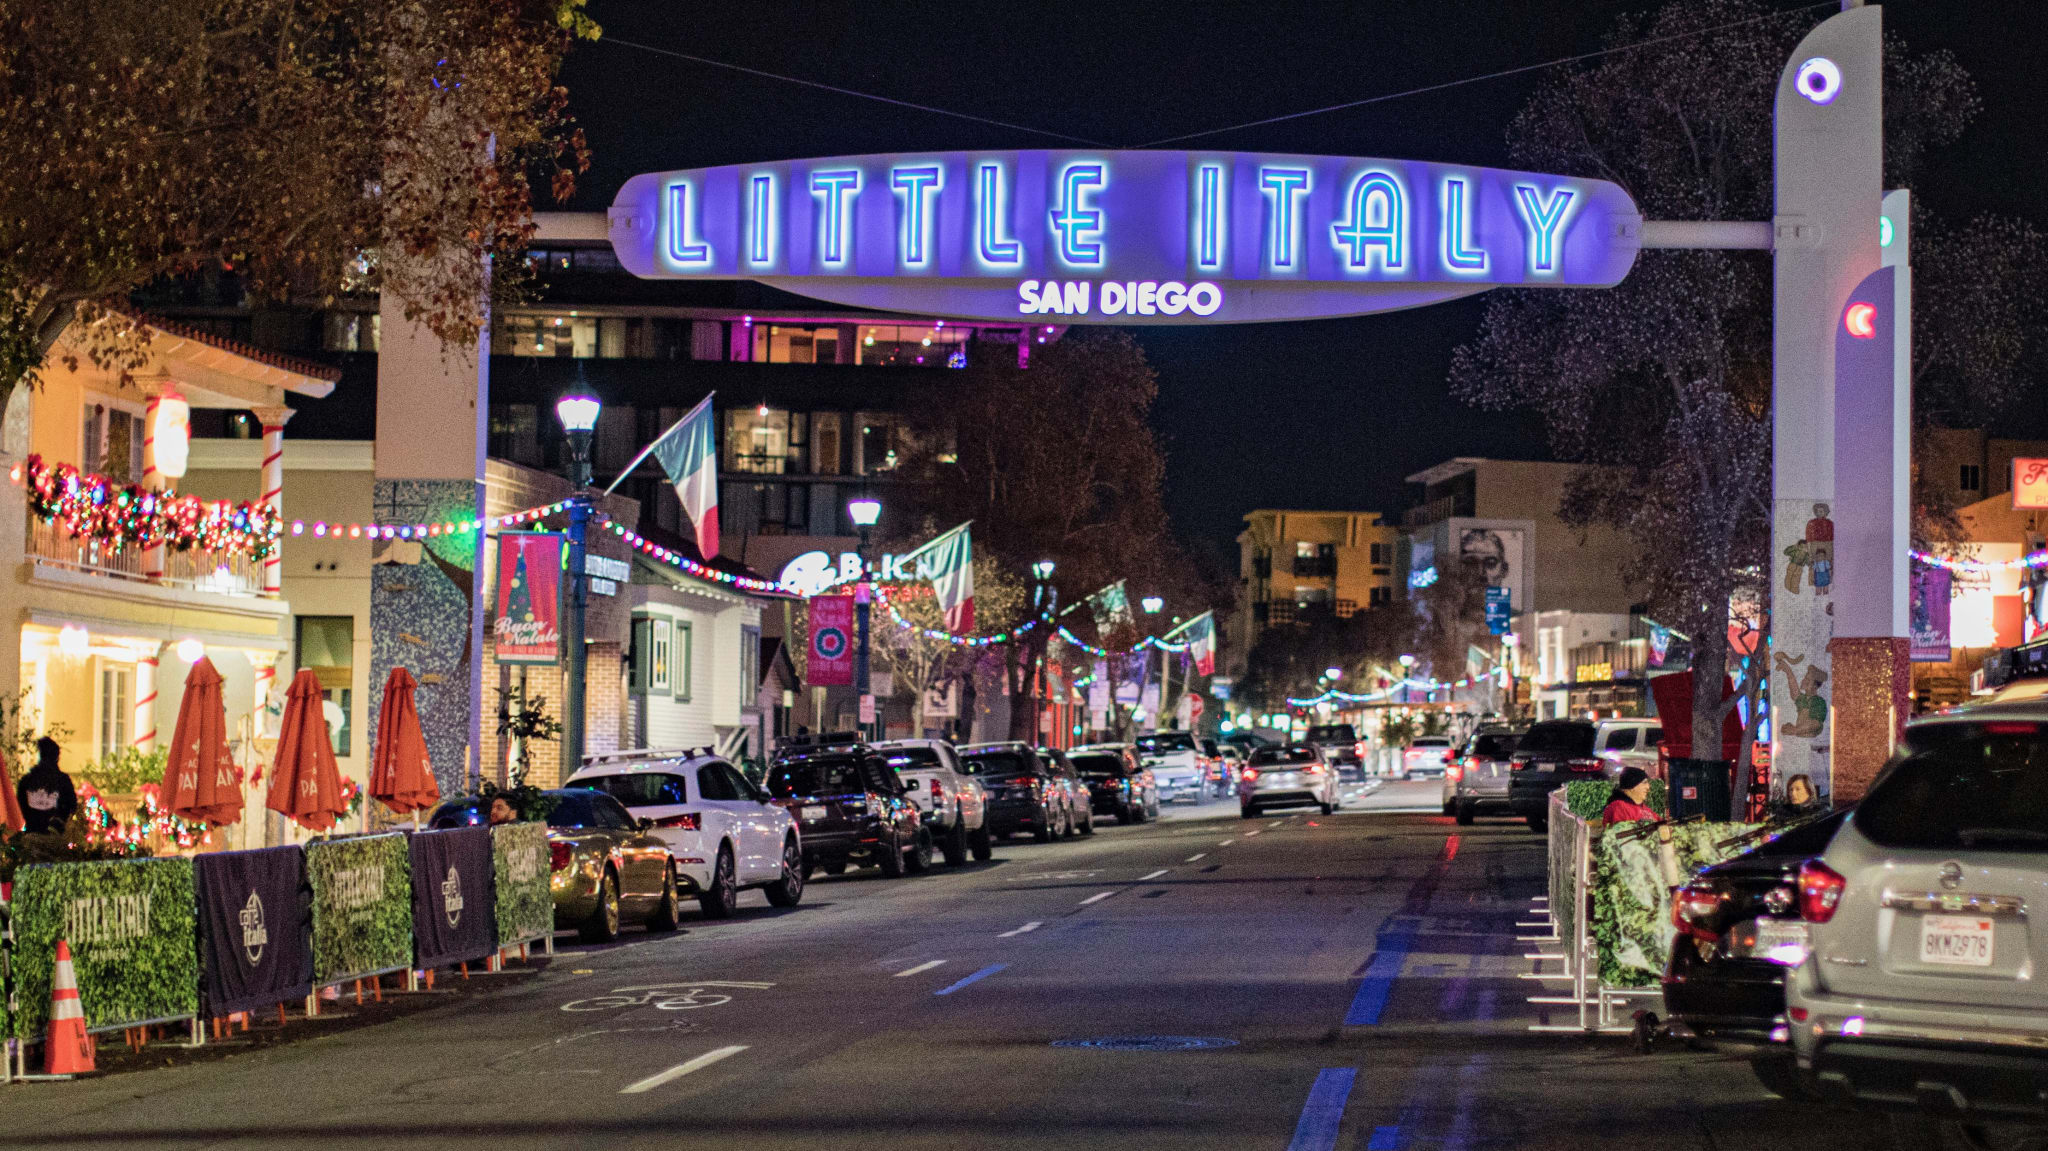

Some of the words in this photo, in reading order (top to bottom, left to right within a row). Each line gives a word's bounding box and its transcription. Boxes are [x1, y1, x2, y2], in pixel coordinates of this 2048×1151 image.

[666, 161, 1106, 267] LITTLE
[1196, 163, 1579, 274] ITALY
[1018, 279, 1092, 316] SAN
[1099, 280, 1224, 317] DIEGO
[493, 616, 548, 636] Buon
[505, 628, 560, 646] Natale
